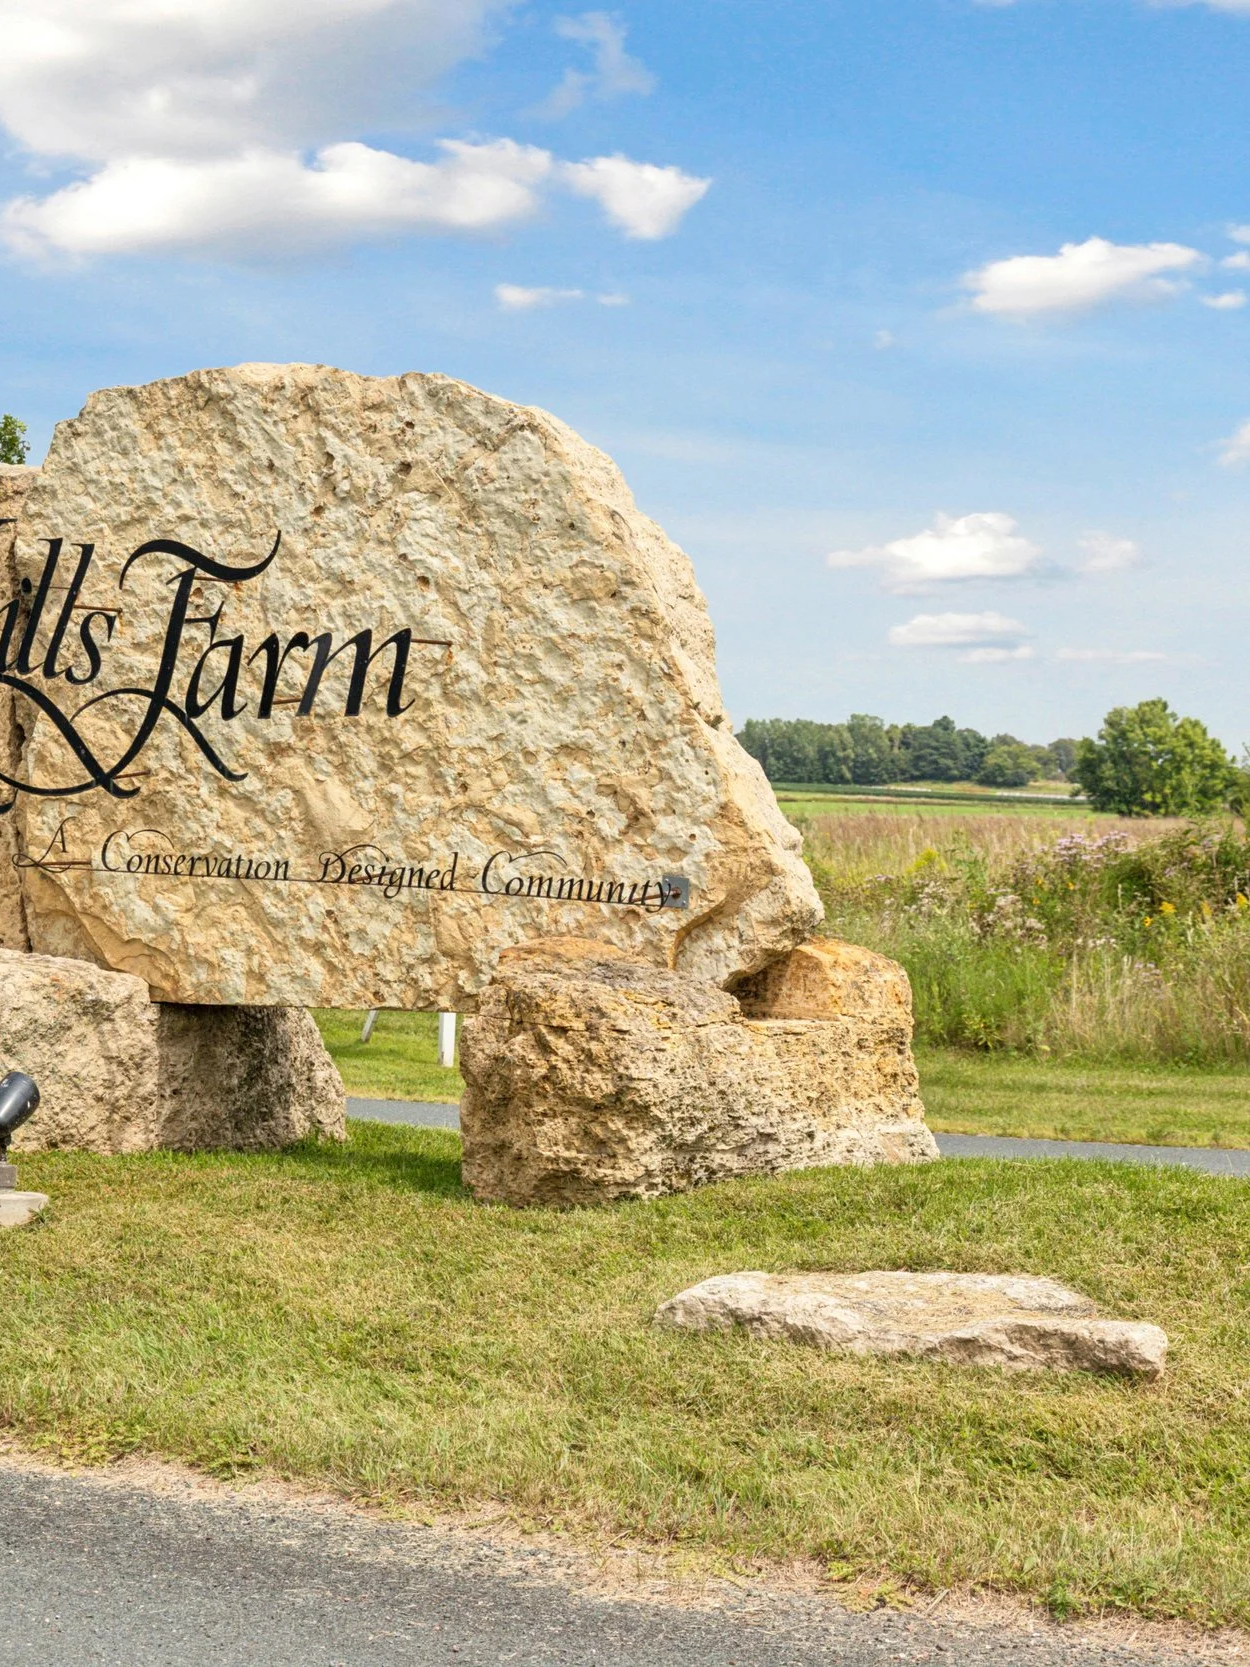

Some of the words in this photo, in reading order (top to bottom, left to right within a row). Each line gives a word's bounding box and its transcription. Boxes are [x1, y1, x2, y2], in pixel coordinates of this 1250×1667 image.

[119, 529, 416, 760] Farm
[12, 816, 77, 873] A
[101, 829, 290, 880] Conservation
[317, 844, 457, 899] Designed
[481, 850, 672, 912] Community
